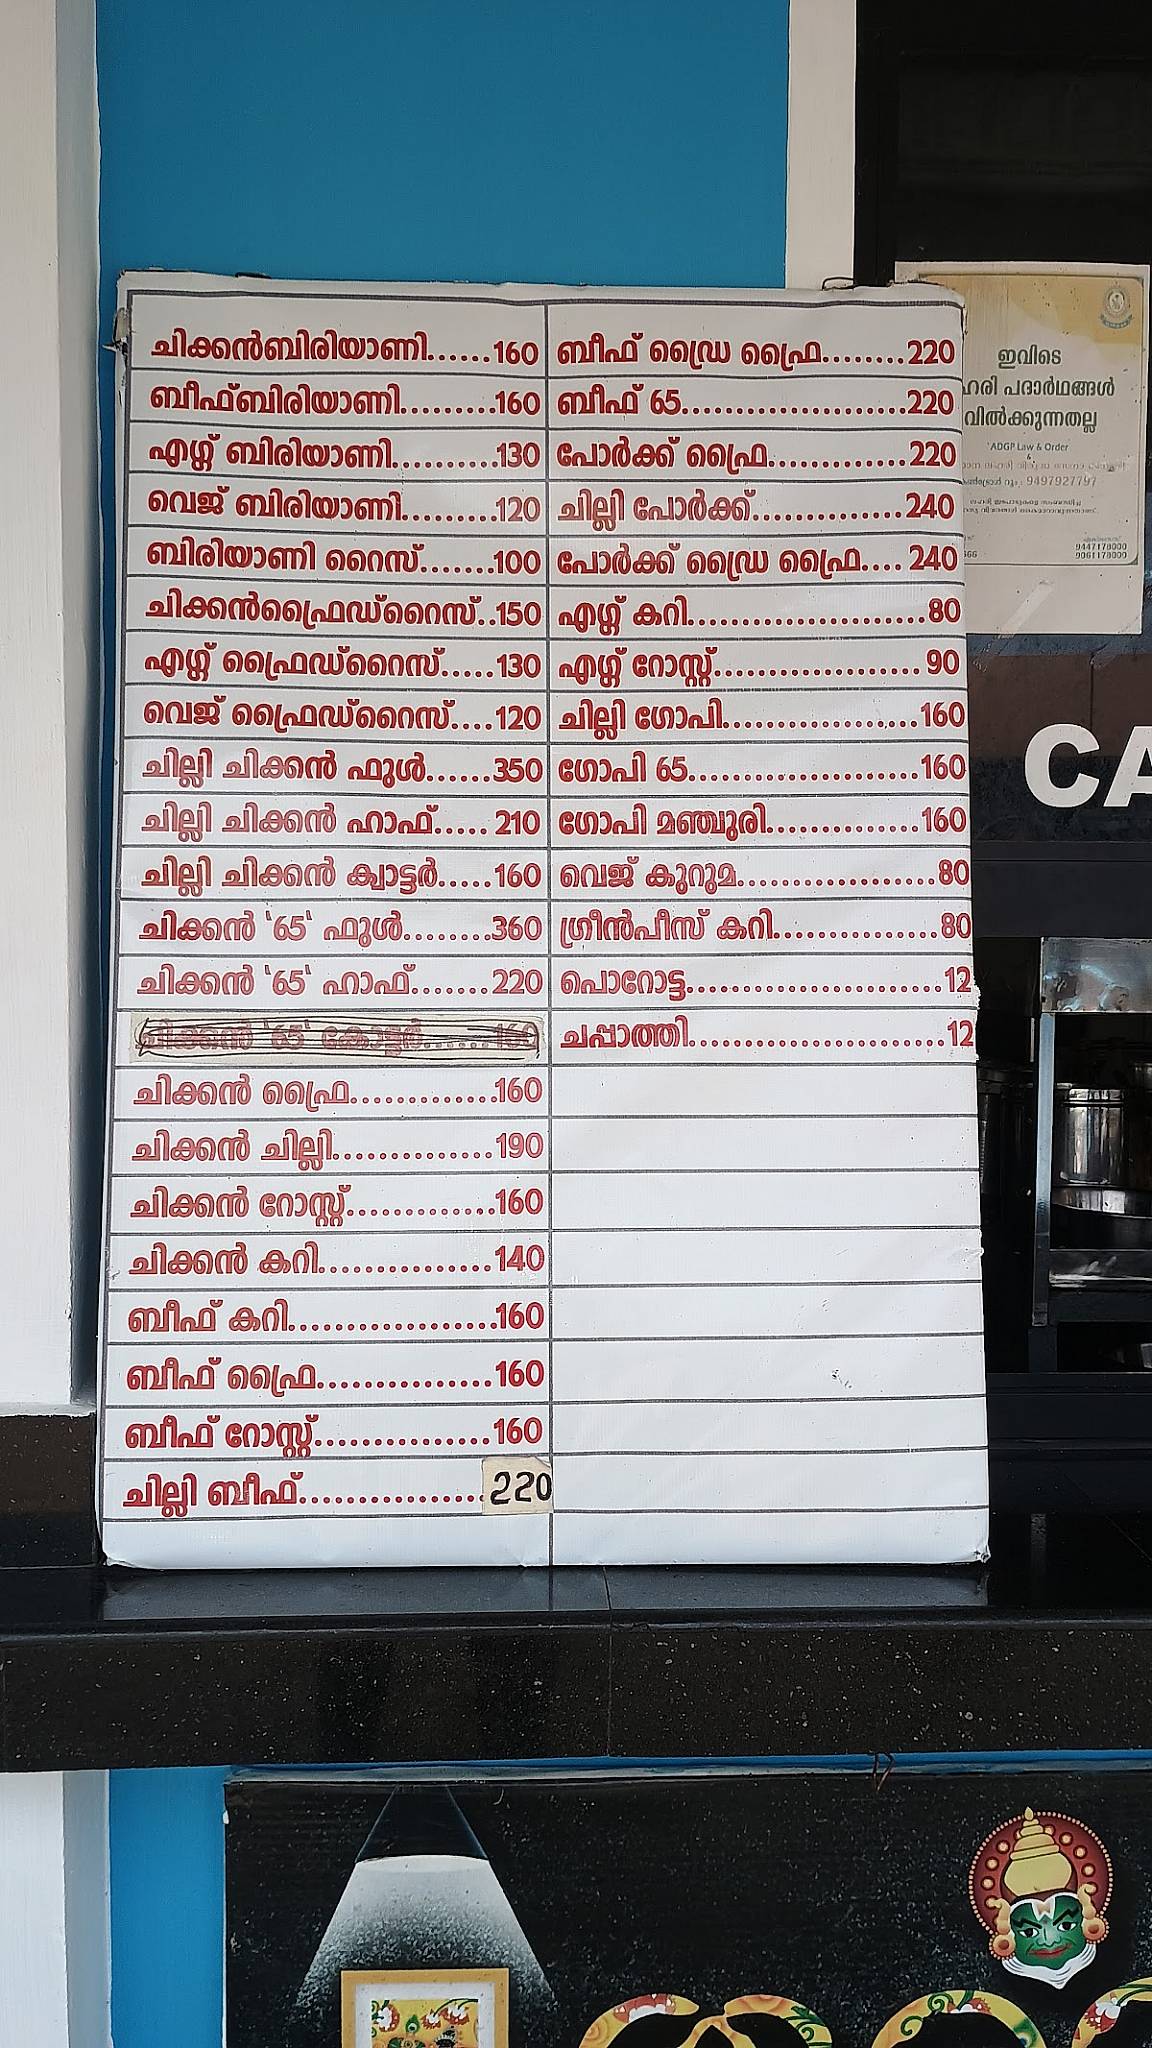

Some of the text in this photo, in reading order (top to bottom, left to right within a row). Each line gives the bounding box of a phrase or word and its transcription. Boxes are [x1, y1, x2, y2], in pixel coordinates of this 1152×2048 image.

[493, 339, 540, 368] 160
[907, 338, 956, 366] 220
[997, 344, 1062, 369] ഇവിടെ
[962, 376, 998, 396] ഹരി
[495, 389, 543, 417] 160
[648, 387, 684, 417] 65
[905, 387, 956, 417] 220
[495, 440, 541, 469] 130
[910, 439, 958, 469] 220
[496, 495, 542, 522] 120
[905, 491, 956, 521] 240
[492, 548, 542, 576] 100
[910, 543, 960, 573] 240
[495, 599, 543, 627] 150
[927, 597, 961, 625] 80
[496, 651, 542, 680] 130
[926, 648, 960, 676] 90
[495, 703, 543, 731] 120
[920, 700, 966, 728] 160
[492, 755, 544, 784] 350
[655, 755, 689, 783] 65
[920, 753, 967, 781] 160
[495, 809, 541, 837] 210
[921, 806, 968, 833] 160
[495, 863, 543, 889] 160
[938, 858, 970, 887] 80
[490, 915, 543, 942] 360
[940, 911, 973, 939] 80
[492, 968, 544, 995] 220
[944, 965, 972, 993] 12
[948, 1019, 975, 1048] 12
[494, 1076, 543, 1104] 160
[496, 1131, 544, 1159] 190
[495, 1187, 545, 1216] 160
[495, 1243, 545, 1273] 140
[494, 1301, 545, 1330] 160
[495, 1359, 545, 1388] 160
[492, 1416, 543, 1445] 160
[490, 1470, 553, 1506] 220
